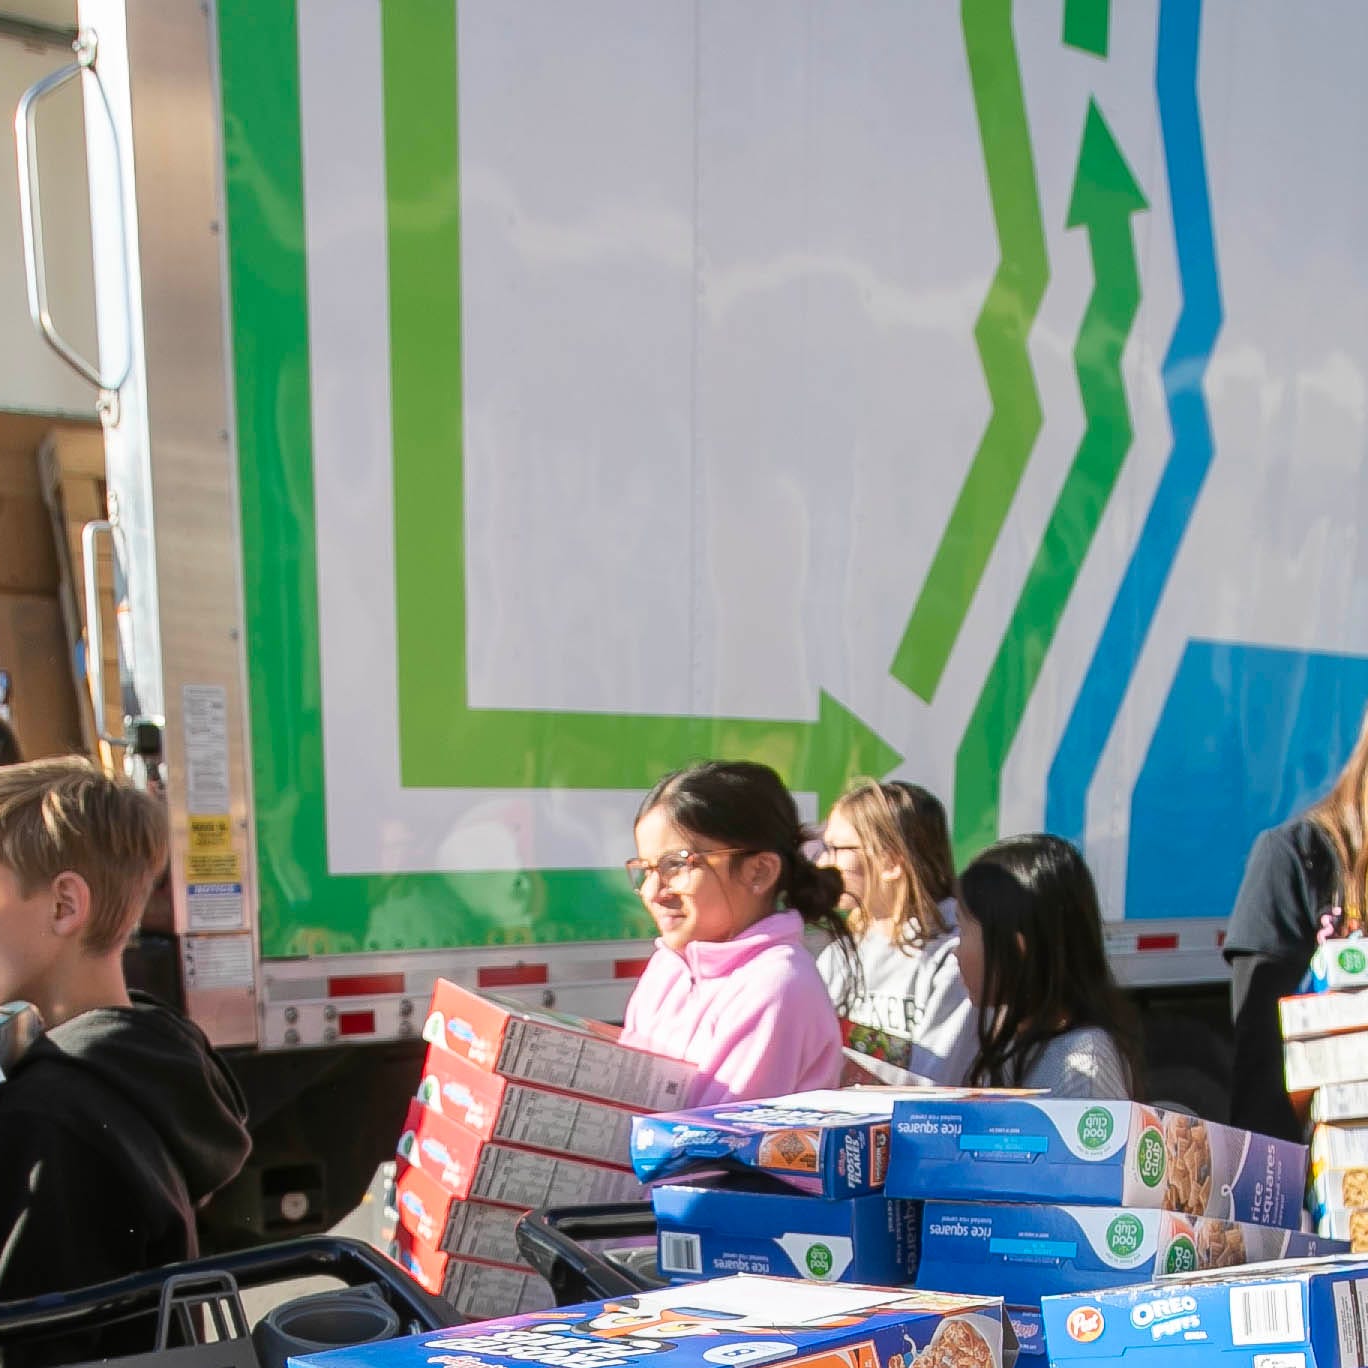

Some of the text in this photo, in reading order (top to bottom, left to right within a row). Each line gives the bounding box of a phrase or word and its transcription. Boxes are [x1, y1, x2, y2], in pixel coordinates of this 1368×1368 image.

[897, 1121, 962, 1135] rice squares
[1085, 1113, 1108, 1127] club
[1083, 1127, 1107, 1139] food
[1142, 1138, 1152, 1177] food
[1151, 1141, 1163, 1176] club
[1262, 1144, 1276, 1224] squares
[1251, 1182, 1263, 1222] rice
[929, 1223, 992, 1241] rice squares
[1114, 1223, 1138, 1235] club
[1112, 1235, 1137, 1247] food
[1131, 1296, 1198, 1328] OREO
